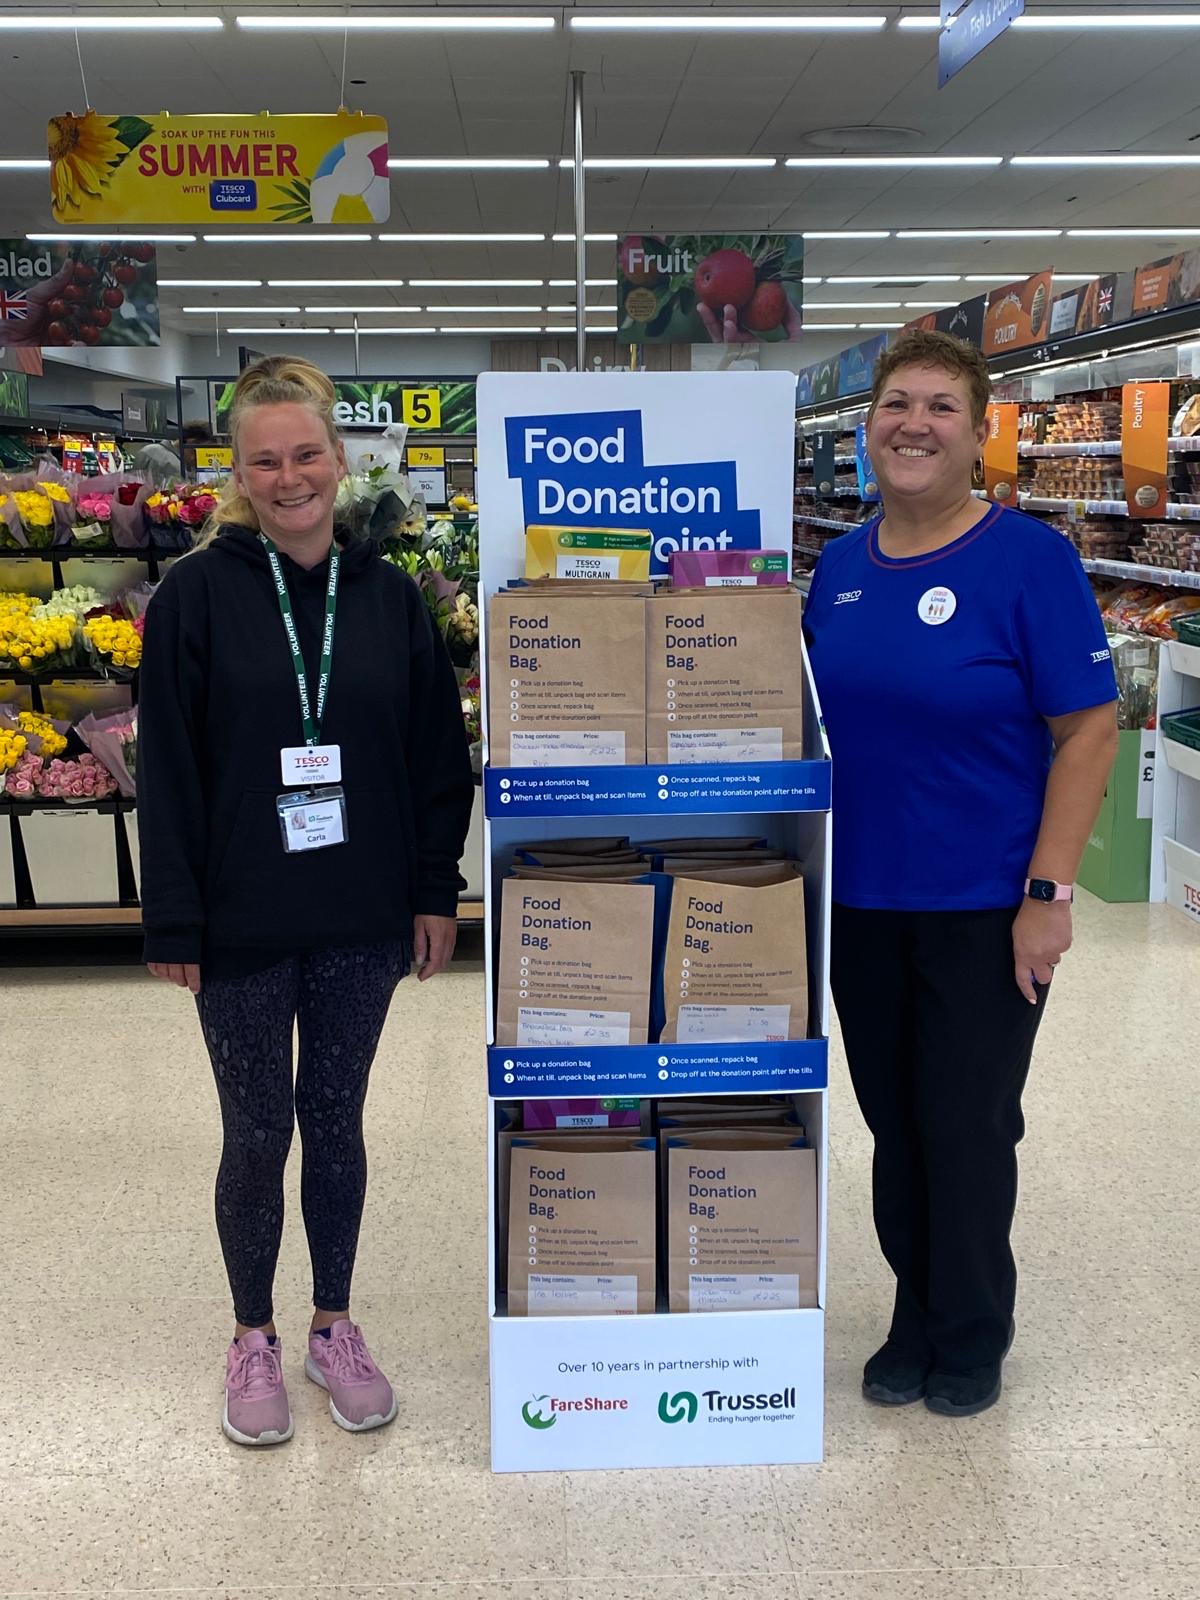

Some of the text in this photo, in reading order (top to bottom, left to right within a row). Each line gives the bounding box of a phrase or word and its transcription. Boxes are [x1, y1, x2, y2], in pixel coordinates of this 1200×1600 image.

[161, 130, 275, 138] SOAK UP THE FUN THIS
[138, 144, 300, 177] SUMMER
[182, 185, 205, 193] WITH
[216, 195, 251, 203] Clubcard
[628, 248, 693, 273] Fruit
[994, 323, 1017, 344] POULTRY
[412, 394, 431, 424] 5
[1132, 389, 1146, 429] Poultry
[991, 408, 1001, 439] Poultry
[524, 427, 625, 464] Food
[538, 477, 721, 515] Donation
[650, 527, 733, 563] oint
[575, 559, 601, 567] TESCO
[268, 552, 286, 596] VOLUNTEER
[328, 556, 338, 596] VOLUNTEER
[565, 569, 611, 580] MULTIGRAIN
[836, 590, 862, 601] TESCO
[509, 615, 549, 629] Food
[665, 614, 704, 628] Food
[283, 612, 300, 656] VOLUNTEER
[323, 613, 334, 656] VOLUNTEER
[666, 634, 737, 649] Donation
[509, 635, 581, 649] Donation
[666, 654, 698, 671] Bag.
[1090, 649, 1110, 661] TESCO
[509, 655, 542, 671] Bag.
[297, 673, 310, 720] VOLUNTEER
[295, 755, 329, 765] TESCO
[747, 775, 760, 783] bag
[1143, 766, 1153, 781] £
[576, 779, 589, 787] bag
[581, 793, 594, 801] bag
[671, 790, 688, 798] Drop
[754, 789, 771, 797] point
[307, 834, 326, 843] Carla
[522, 896, 561, 910] Food
[688, 896, 723, 914] Food
[522, 915, 591, 930] Donation
[686, 916, 753, 934] Donation
[521, 933, 552, 950] Bag.
[684, 934, 713, 954] Bag.
[578, 1060, 591, 1068] bag
[721, 1056, 744, 1064] repack
[745, 1055, 758, 1063] bag
[583, 1074, 596, 1082] bag
[670, 1071, 688, 1079] Drop
[752, 1069, 769, 1077] point
[529, 1166, 565, 1181] Food
[688, 1165, 726, 1180] Food
[529, 1184, 596, 1200] Donation
[688, 1184, 757, 1198] Donation
[528, 1202, 558, 1220] Bag.
[689, 1202, 719, 1219] Bag.
[557, 1357, 758, 1373] Over 10 years in partnership with
[550, 1397, 628, 1412] FareShare
[702, 1387, 796, 1412] Trussell
[708, 1413, 795, 1424] Ending hunger together
